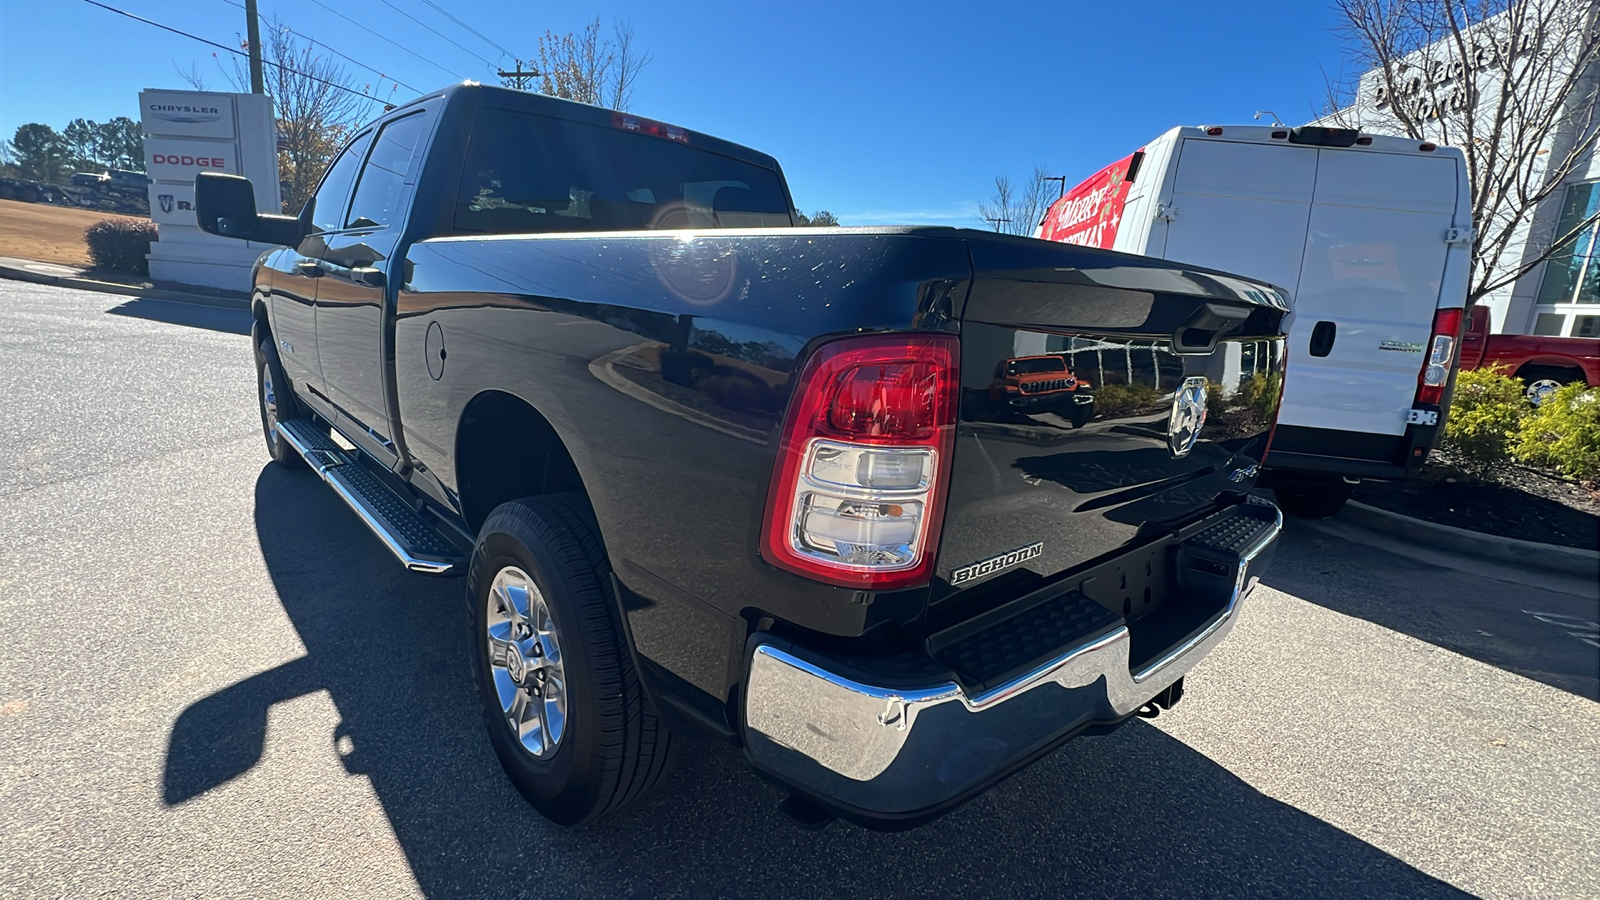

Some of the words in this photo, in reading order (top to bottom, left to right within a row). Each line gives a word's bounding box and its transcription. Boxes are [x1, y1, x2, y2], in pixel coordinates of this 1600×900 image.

[149, 104, 219, 114] CHRYSLER
[152, 154, 225, 168] DODGE
[950, 541, 1044, 587] BIGHORN
